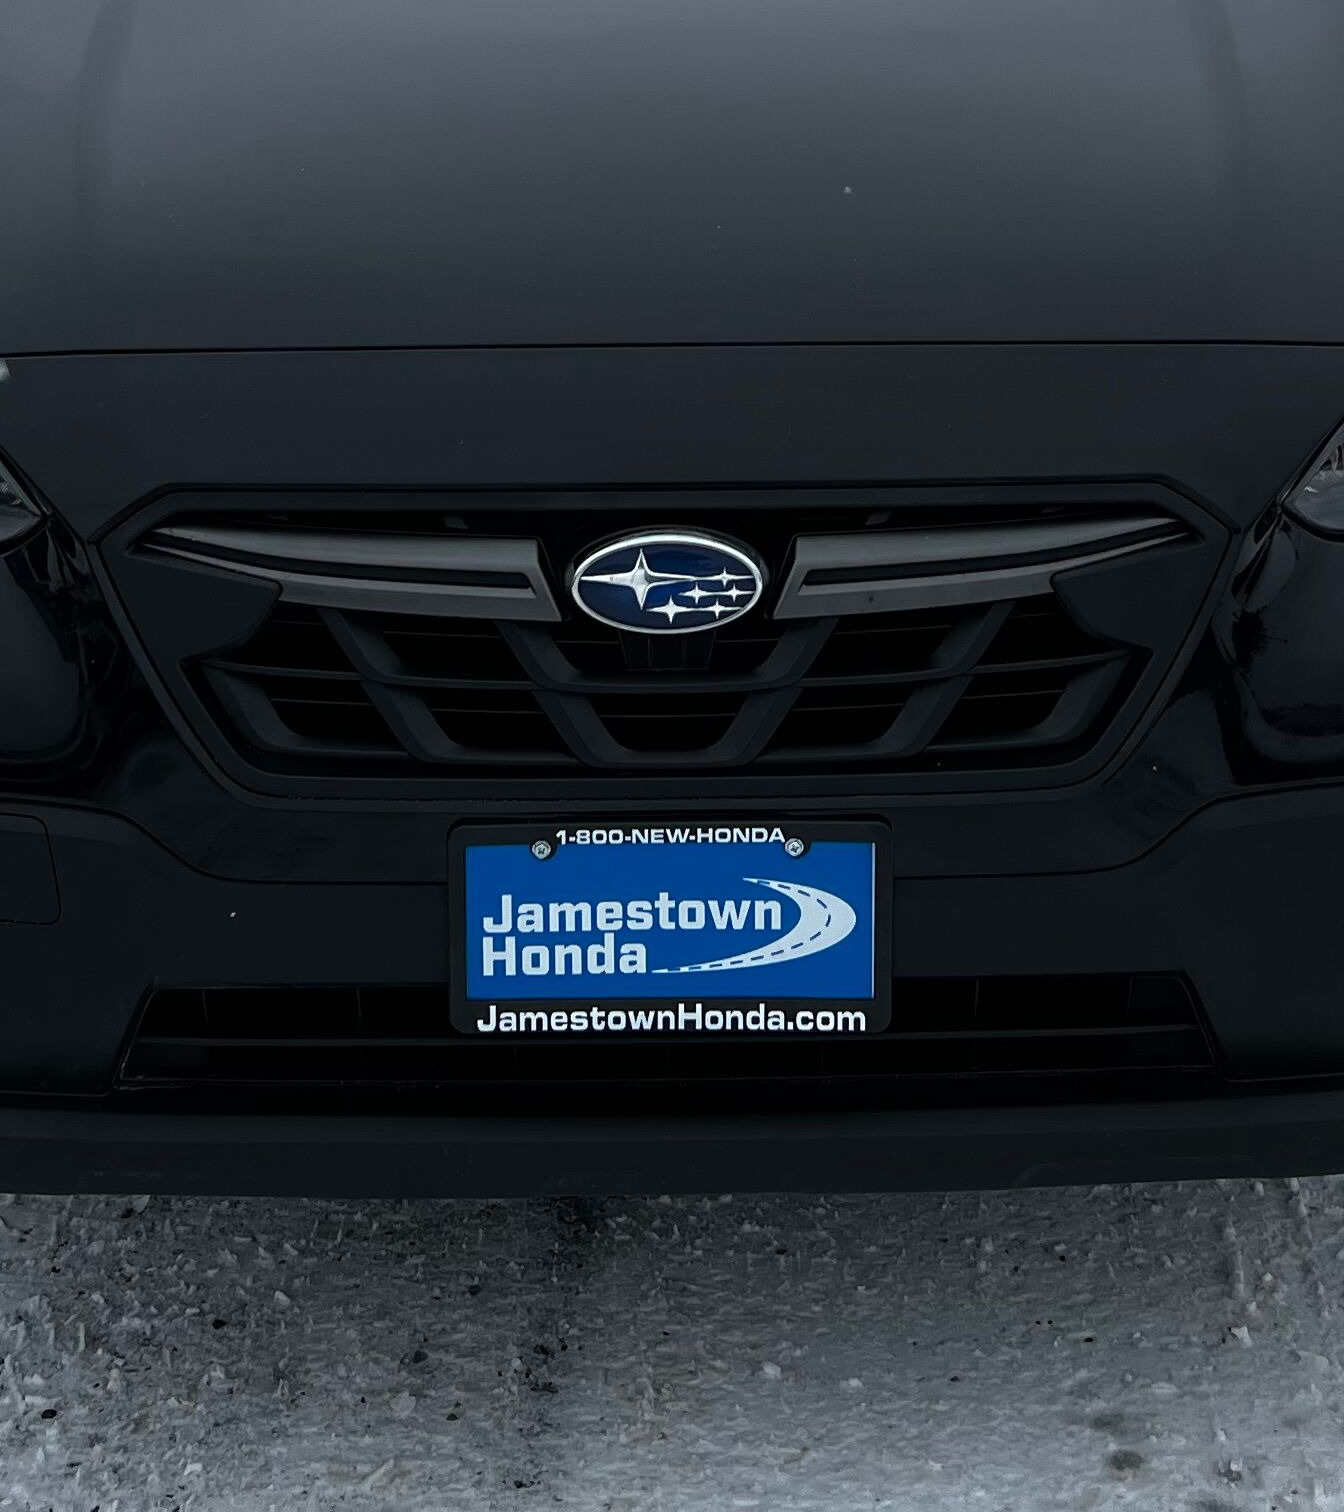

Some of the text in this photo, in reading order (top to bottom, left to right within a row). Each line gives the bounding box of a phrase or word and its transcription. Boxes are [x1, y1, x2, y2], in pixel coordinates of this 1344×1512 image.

[555, 827, 786, 846] 1-800-NEW-HONDA
[482, 891, 782, 934] Jamestown
[482, 933, 647, 976] Honda
[476, 1003, 867, 1033] JamestownHonda.com
